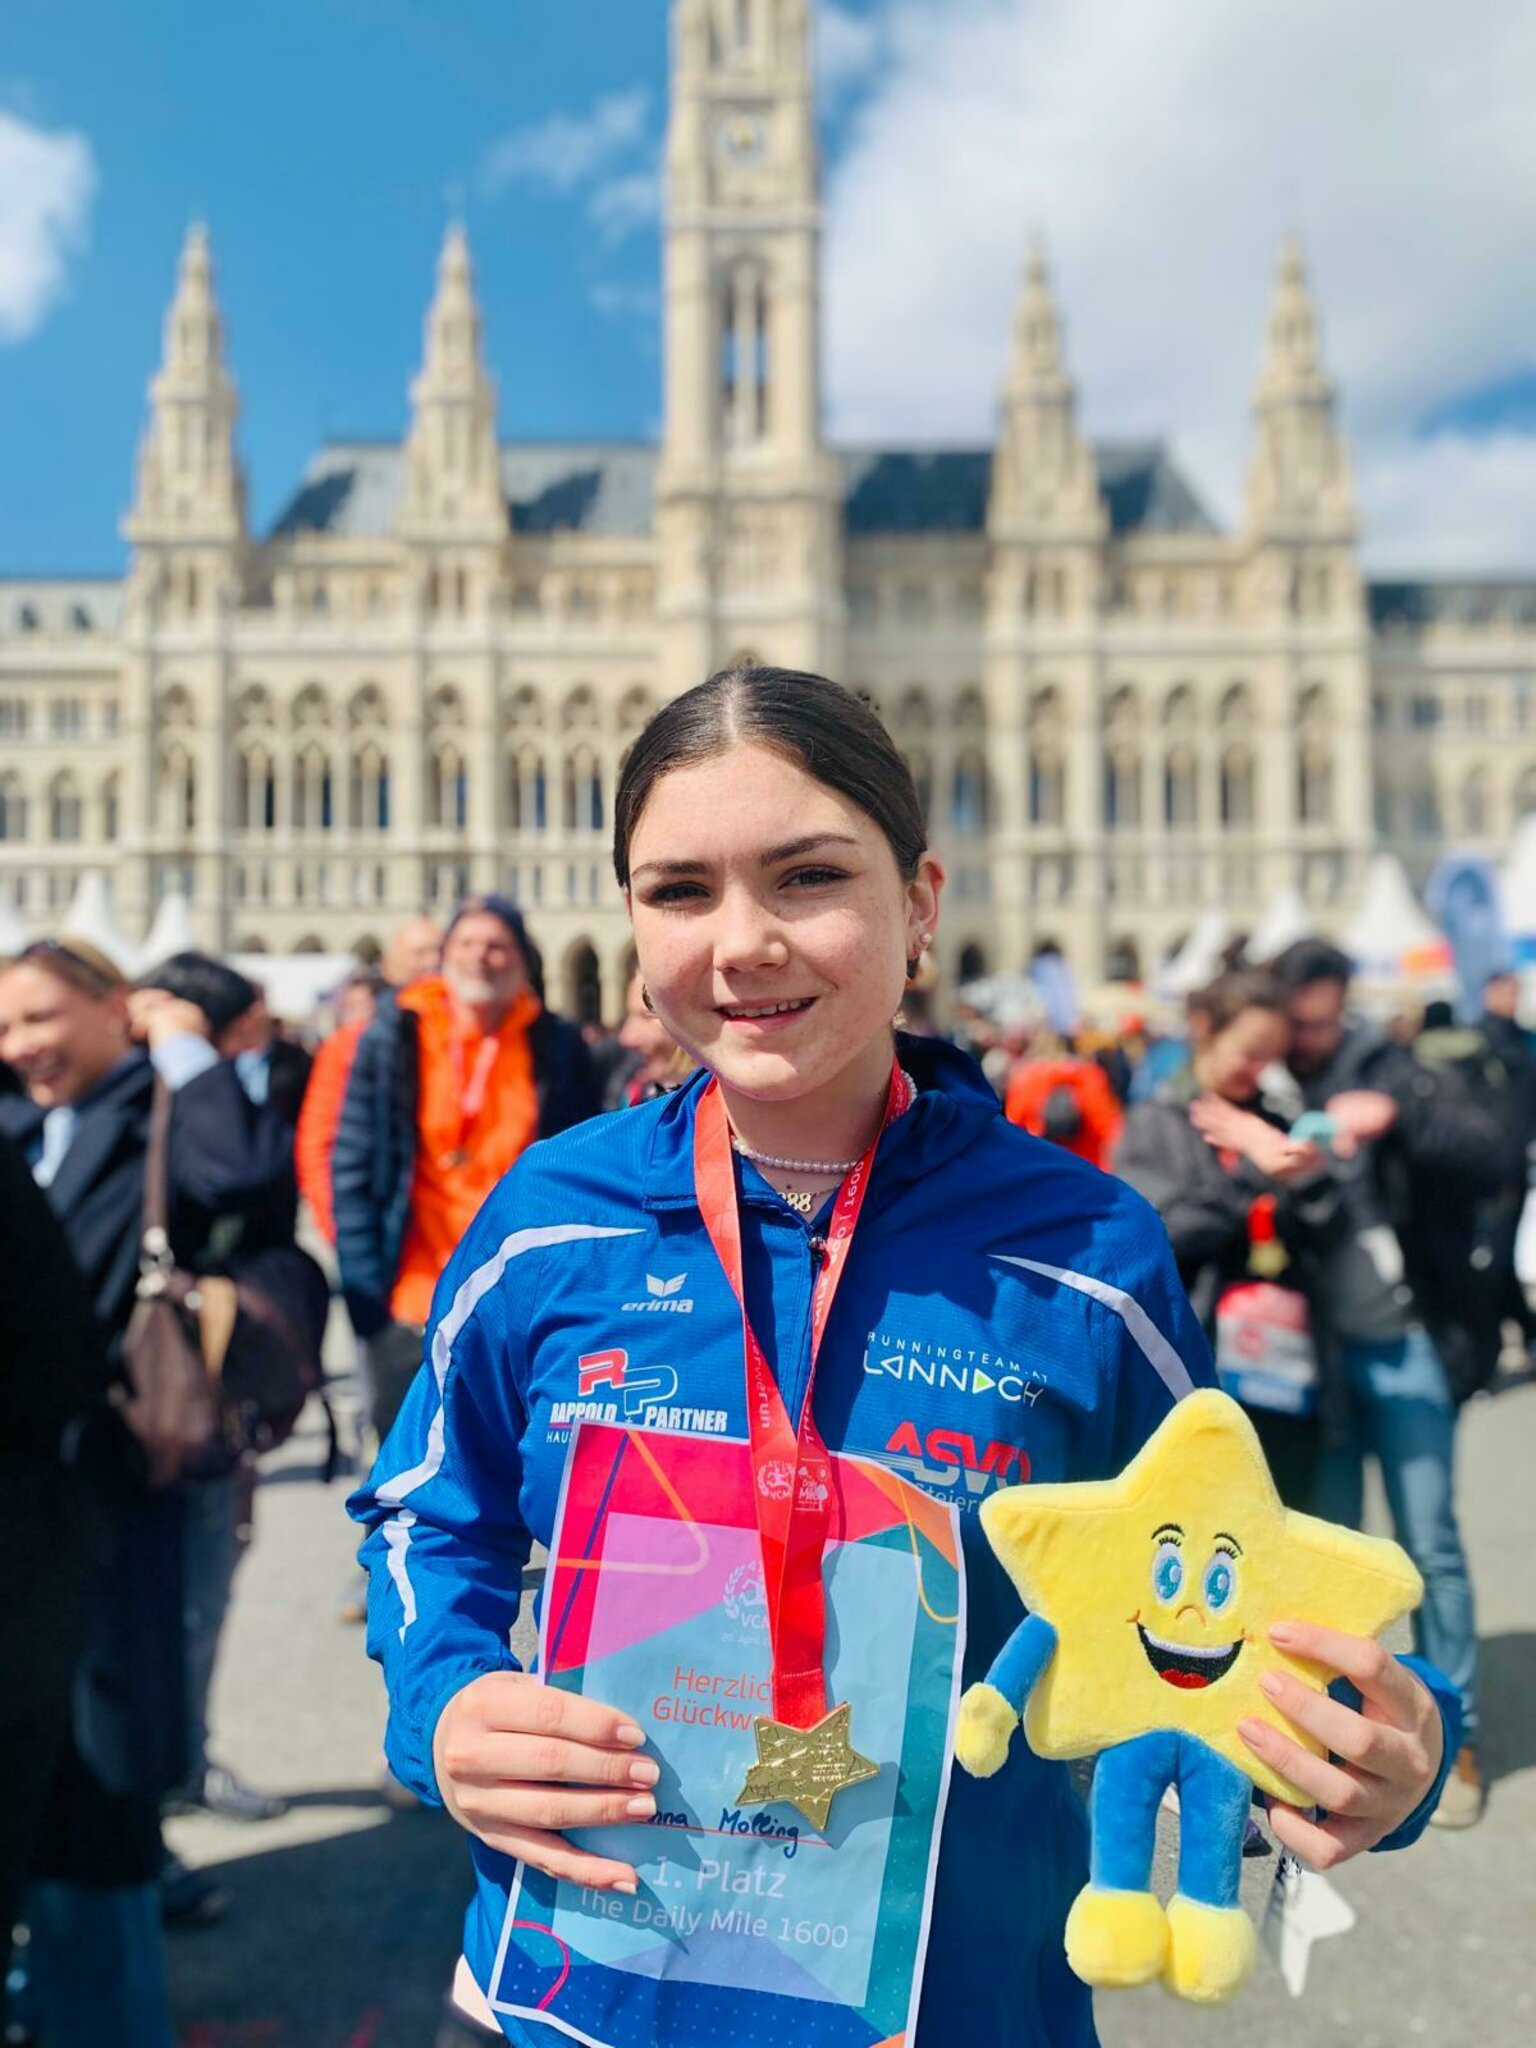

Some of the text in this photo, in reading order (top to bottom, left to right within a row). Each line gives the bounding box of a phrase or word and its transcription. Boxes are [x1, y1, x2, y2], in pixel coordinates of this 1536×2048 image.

[843, 1160, 865, 1207] 1600
[621, 1299, 693, 1313] erima
[643, 1406, 728, 1432] PARTNER
[770, 1490, 791, 1500] VCM
[652, 1855, 788, 1898] 1. Platz
[580, 1887, 850, 1949] The Daily Mile 1600
